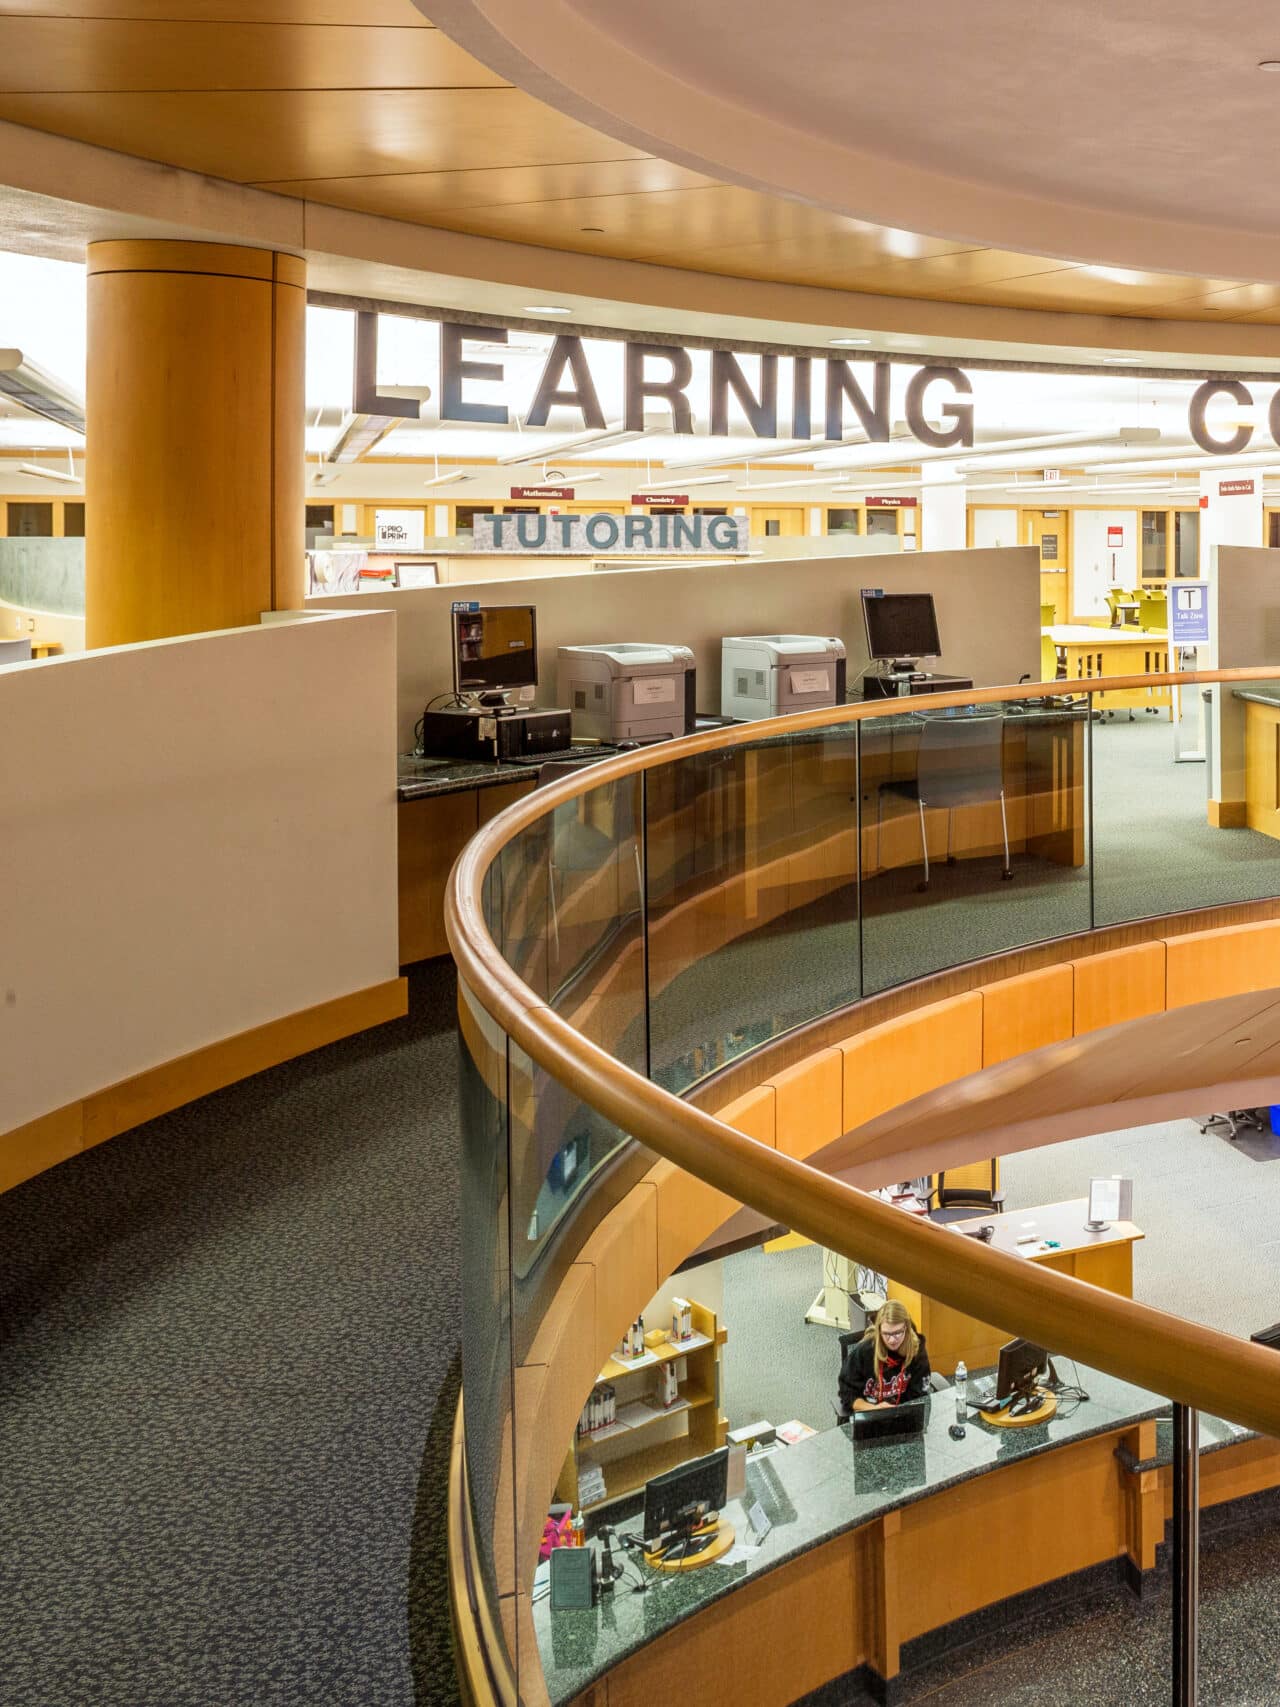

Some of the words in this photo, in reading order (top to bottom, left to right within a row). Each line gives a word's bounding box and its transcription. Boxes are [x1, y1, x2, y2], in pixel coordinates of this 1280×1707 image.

[353, 311, 974, 448] LEARNING
[523, 489, 563, 497] Mathematics
[484, 512, 738, 550] TUTORING
[1184, 590, 1195, 608] T
